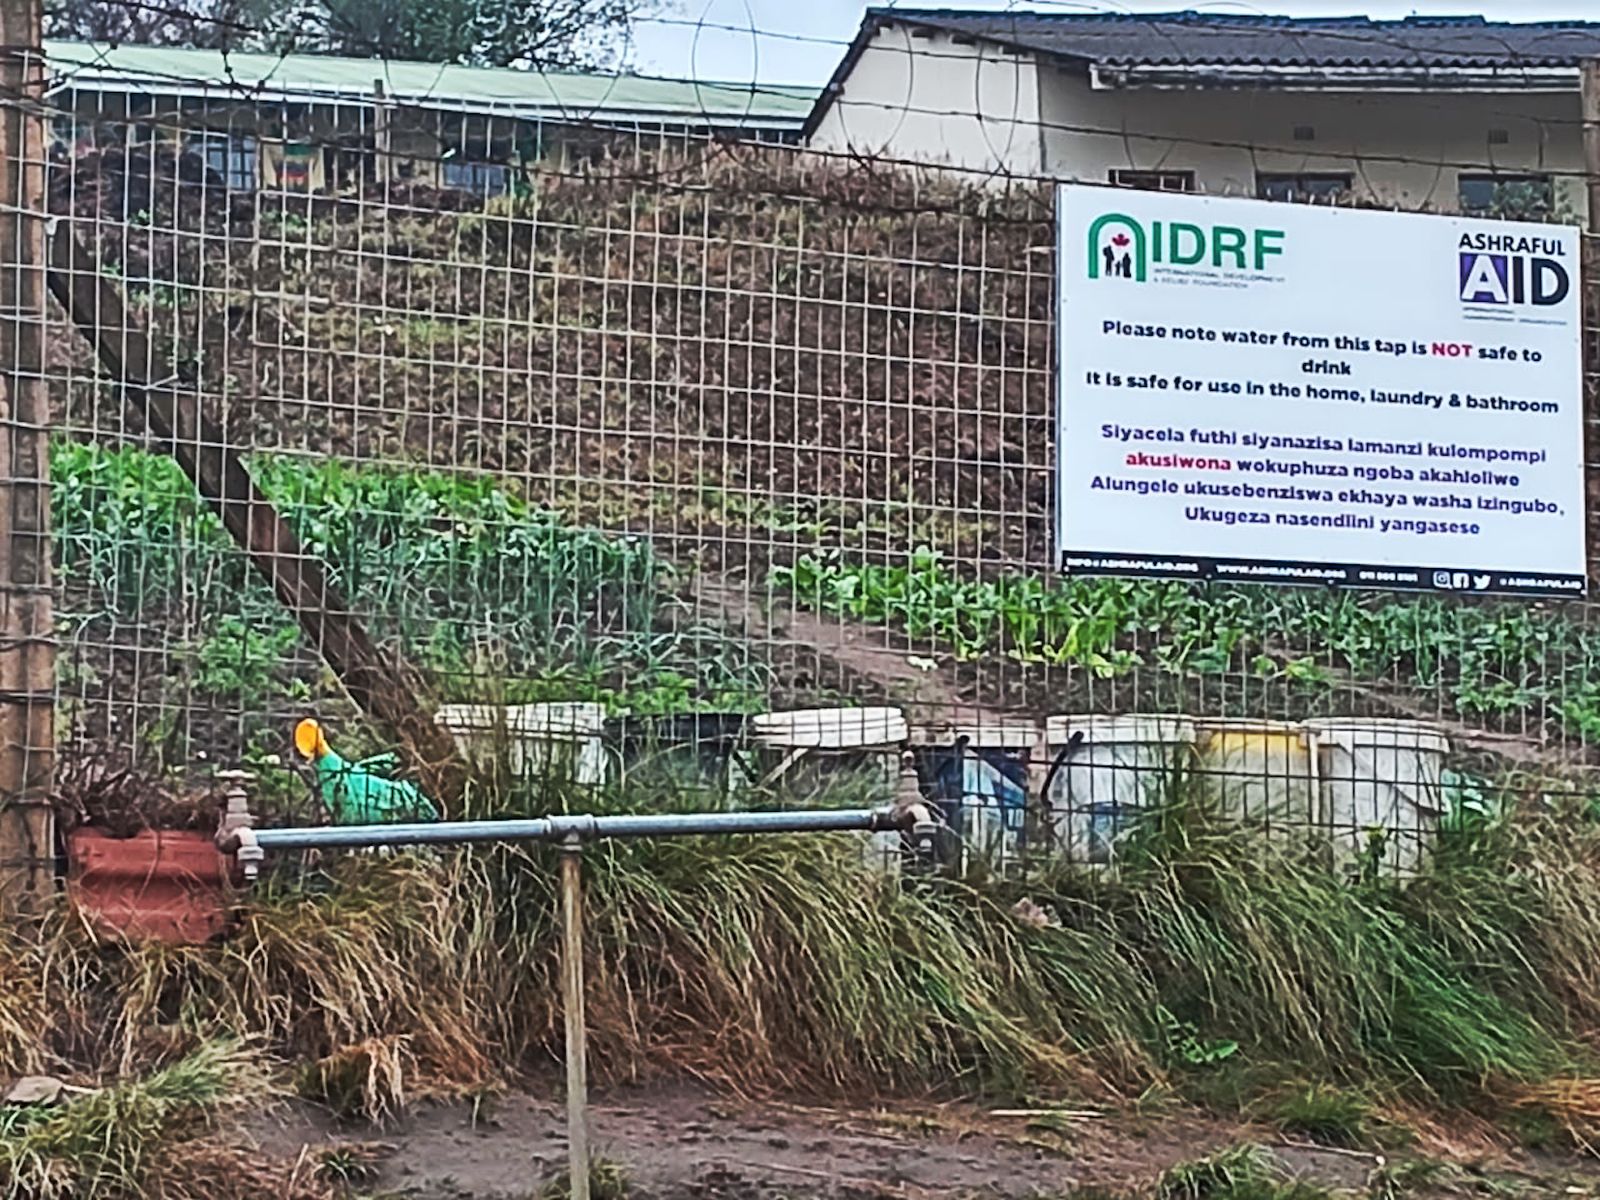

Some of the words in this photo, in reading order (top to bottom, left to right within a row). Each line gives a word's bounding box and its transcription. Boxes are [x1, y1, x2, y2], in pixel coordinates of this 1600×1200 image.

[1152, 221, 1285, 270] IDRF
[1459, 233, 1566, 256] ASHRAFUL
[1459, 252, 1570, 306] AID
[1103, 321, 1166, 338] Please
[1172, 325, 1216, 341] note
[1222, 330, 1277, 345] water
[1282, 332, 1329, 348] from
[1335, 336, 1370, 351] this
[1375, 339, 1406, 356] tap
[1413, 341, 1427, 355] is
[1432, 343, 1472, 357] NOT
[1478, 346, 1517, 361] safe
[1523, 349, 1542, 362] to
[1302, 359, 1351, 375] drink
[1086, 372, 1100, 385] It
[1106, 372, 1122, 387] is
[1127, 374, 1168, 389] safe
[1173, 376, 1202, 391] for
[1208, 381, 1241, 394] use
[1246, 381, 1264, 395] in
[1269, 382, 1301, 397] the
[1306, 384, 1365, 403] home,
[1370, 389, 1443, 409] laundry
[1450, 395, 1461, 407] &
[1466, 394, 1559, 413] bathroom
[1101, 424, 1184, 442] Siyacela
[1190, 428, 1237, 446] futhi
[1242, 432, 1343, 452] siyanazisa
[1348, 438, 1422, 456] lamanzi
[1428, 443, 1546, 465] kulompompi
[1126, 452, 1231, 470] akusiwona
[1237, 459, 1348, 477] wokuphuza
[1353, 465, 1414, 481] ngoba
[1419, 468, 1520, 487] akahloliwe
[1091, 476, 1179, 494] Alungele
[1184, 481, 1333, 501] ukusebenziswa
[1338, 489, 1407, 507] ekhaya
[1413, 494, 1472, 509] washa
[1477, 496, 1565, 516] izingubo,
[1185, 507, 1270, 525] Ukugeza
[1276, 513, 1374, 529] nasendlini
[1380, 517, 1480, 535] yangasese
